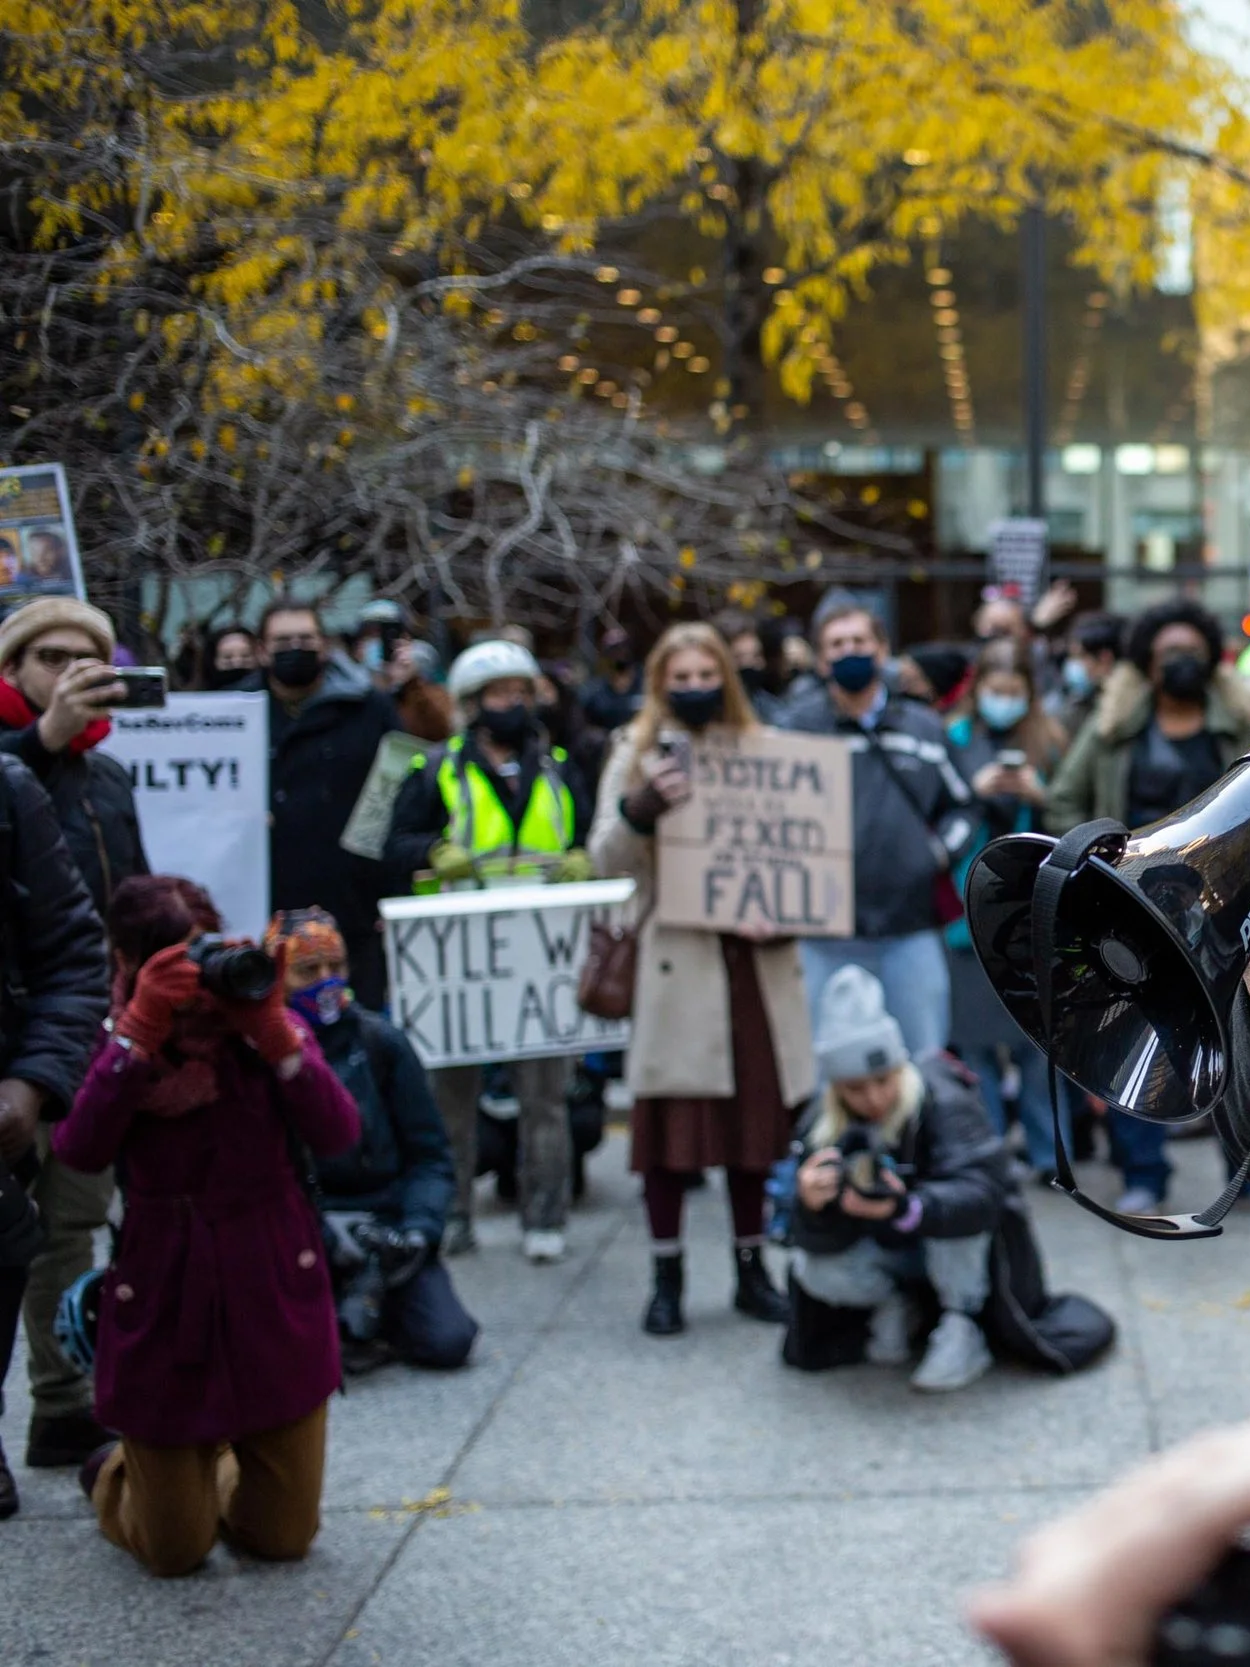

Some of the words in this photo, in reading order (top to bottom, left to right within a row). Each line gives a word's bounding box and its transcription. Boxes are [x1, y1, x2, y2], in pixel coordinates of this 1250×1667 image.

[130, 757, 239, 790] ILTY!
[705, 864, 831, 926] FALL
[392, 910, 516, 986] KYLE
[400, 985, 504, 1057] KILL
